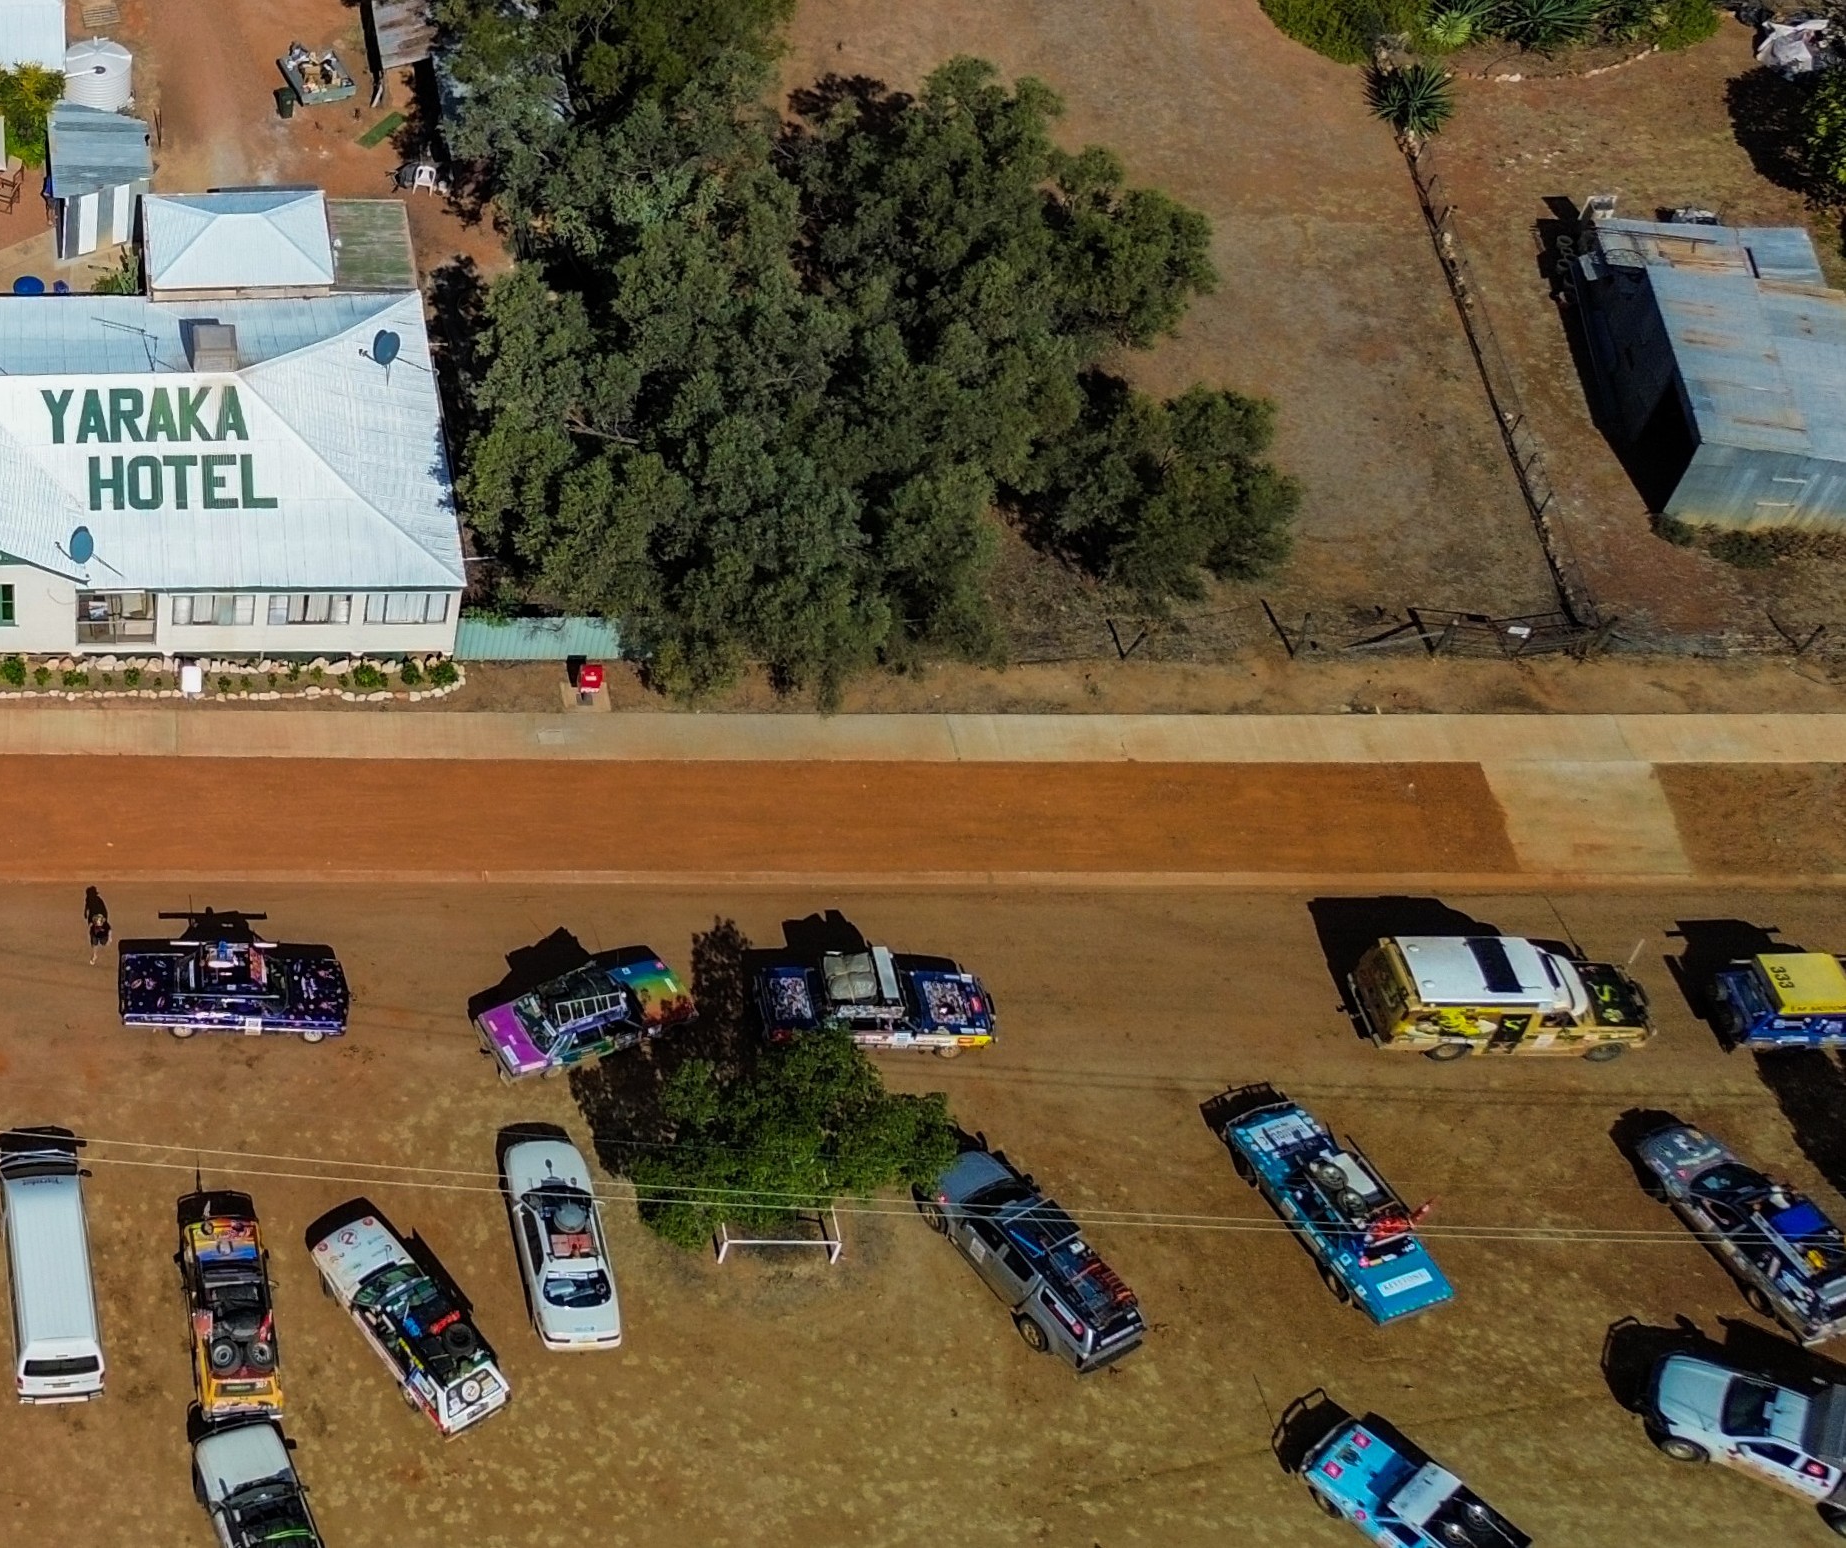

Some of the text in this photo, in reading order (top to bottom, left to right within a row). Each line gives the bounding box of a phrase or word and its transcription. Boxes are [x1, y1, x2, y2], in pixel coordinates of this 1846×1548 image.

[40, 384, 250, 446] YARAKA
[88, 452, 278, 512] HOTEL
[1770, 966, 1795, 989] 333
